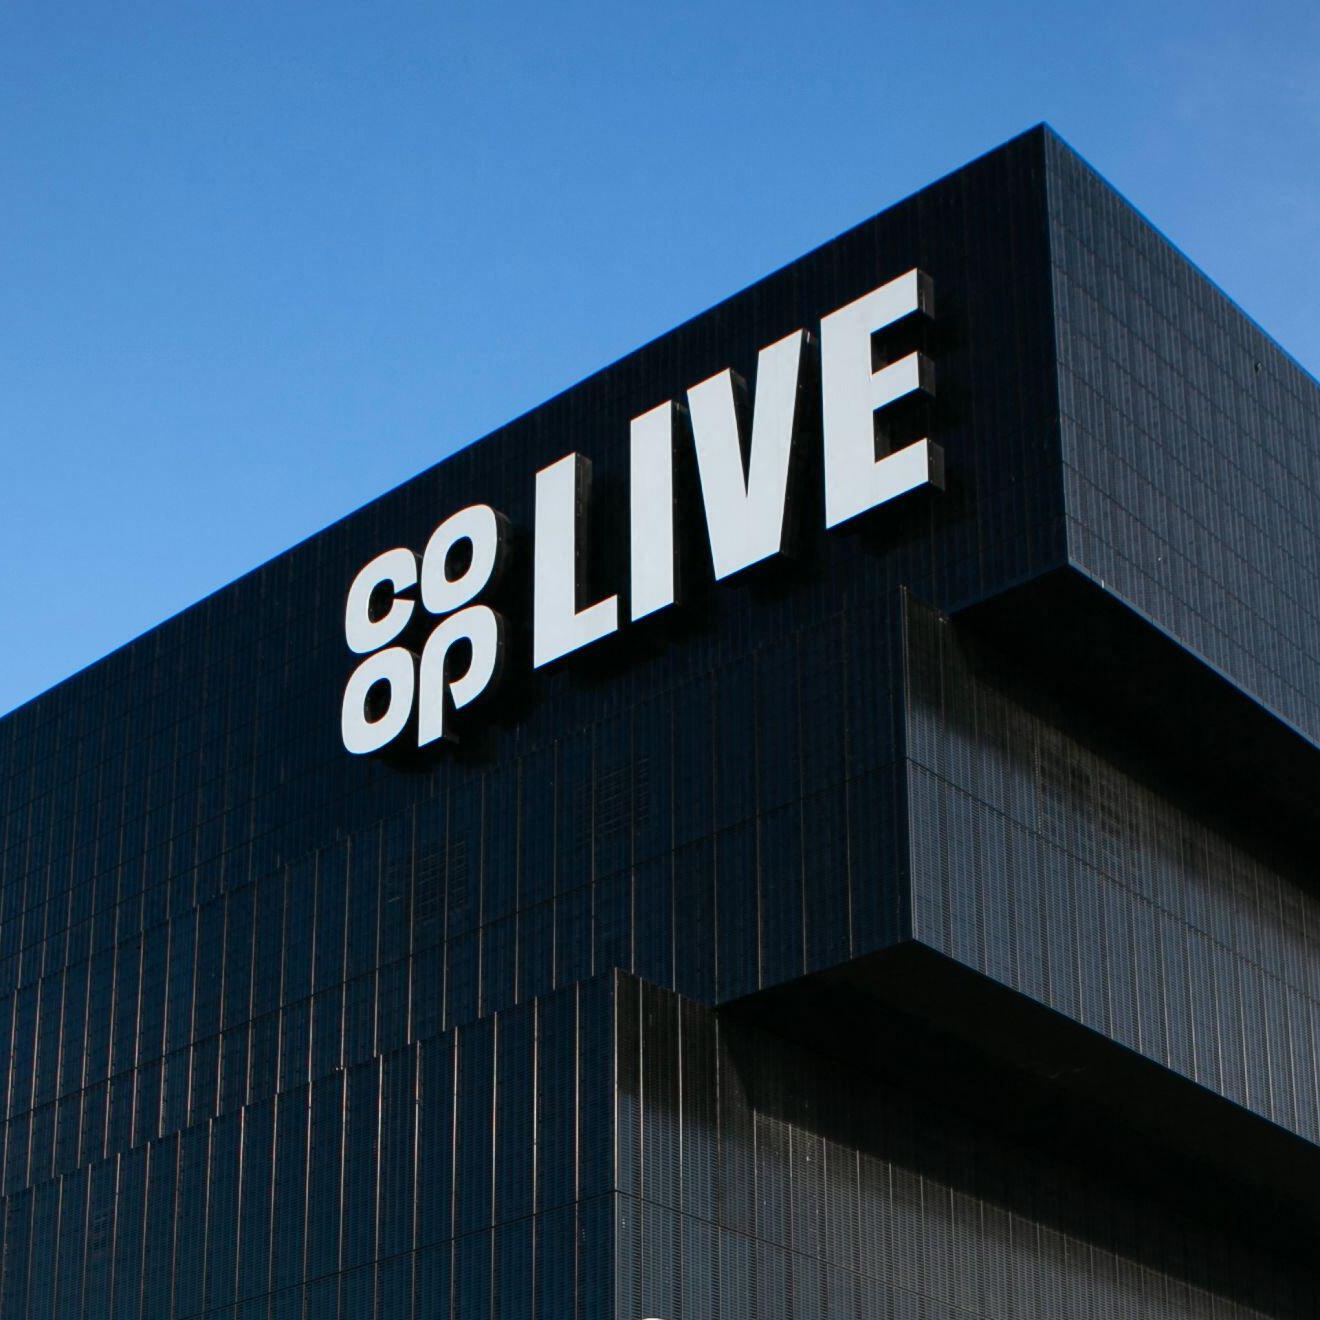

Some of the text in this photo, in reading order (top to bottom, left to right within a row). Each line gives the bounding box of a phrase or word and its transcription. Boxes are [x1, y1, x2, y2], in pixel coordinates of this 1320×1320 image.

[534, 267, 931, 669] LIVE
[345, 504, 498, 654] CO
[341, 604, 498, 754] OP
